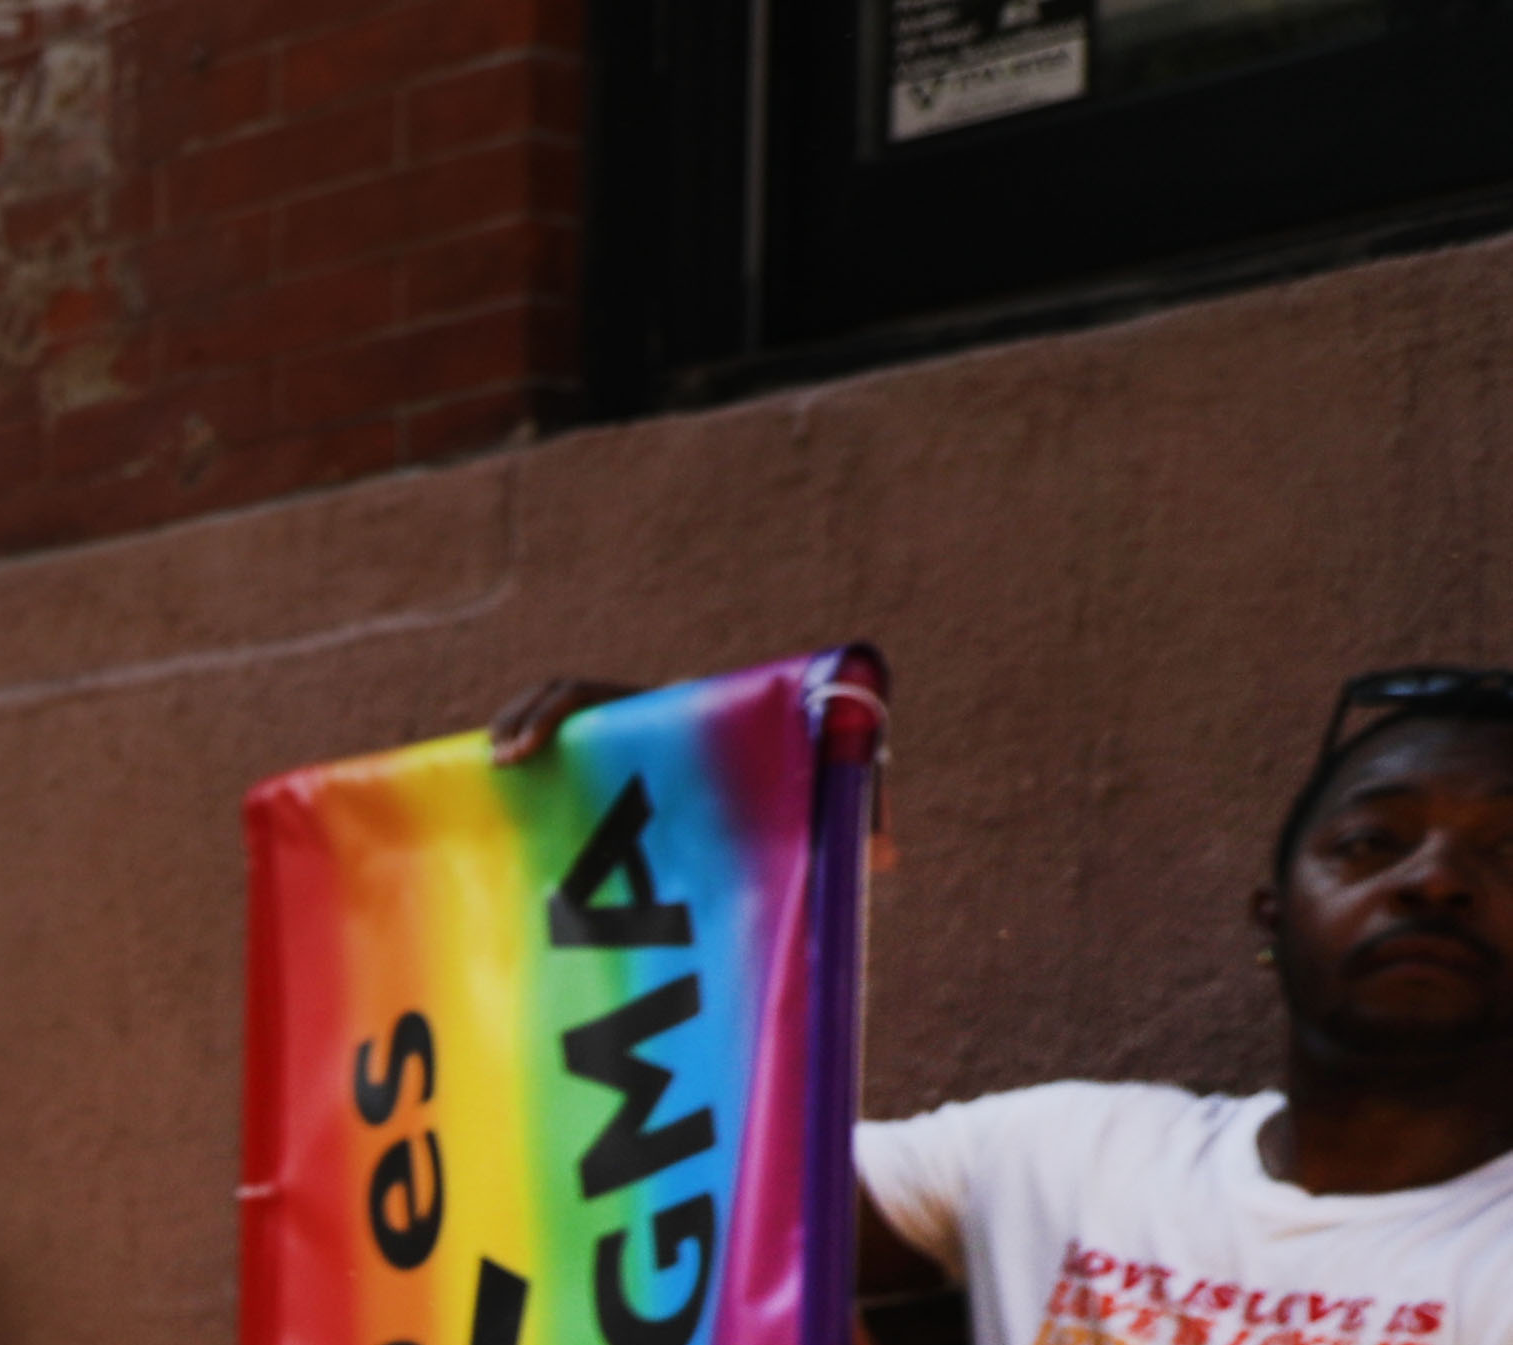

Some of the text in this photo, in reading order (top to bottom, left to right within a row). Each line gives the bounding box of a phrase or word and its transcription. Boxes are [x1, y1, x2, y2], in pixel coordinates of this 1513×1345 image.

[354, 1010, 445, 1271] es
[1182, 1278, 1239, 1312] IS
[1243, 1289, 1374, 1332] LOVE
[1385, 1300, 1446, 1336] IS
